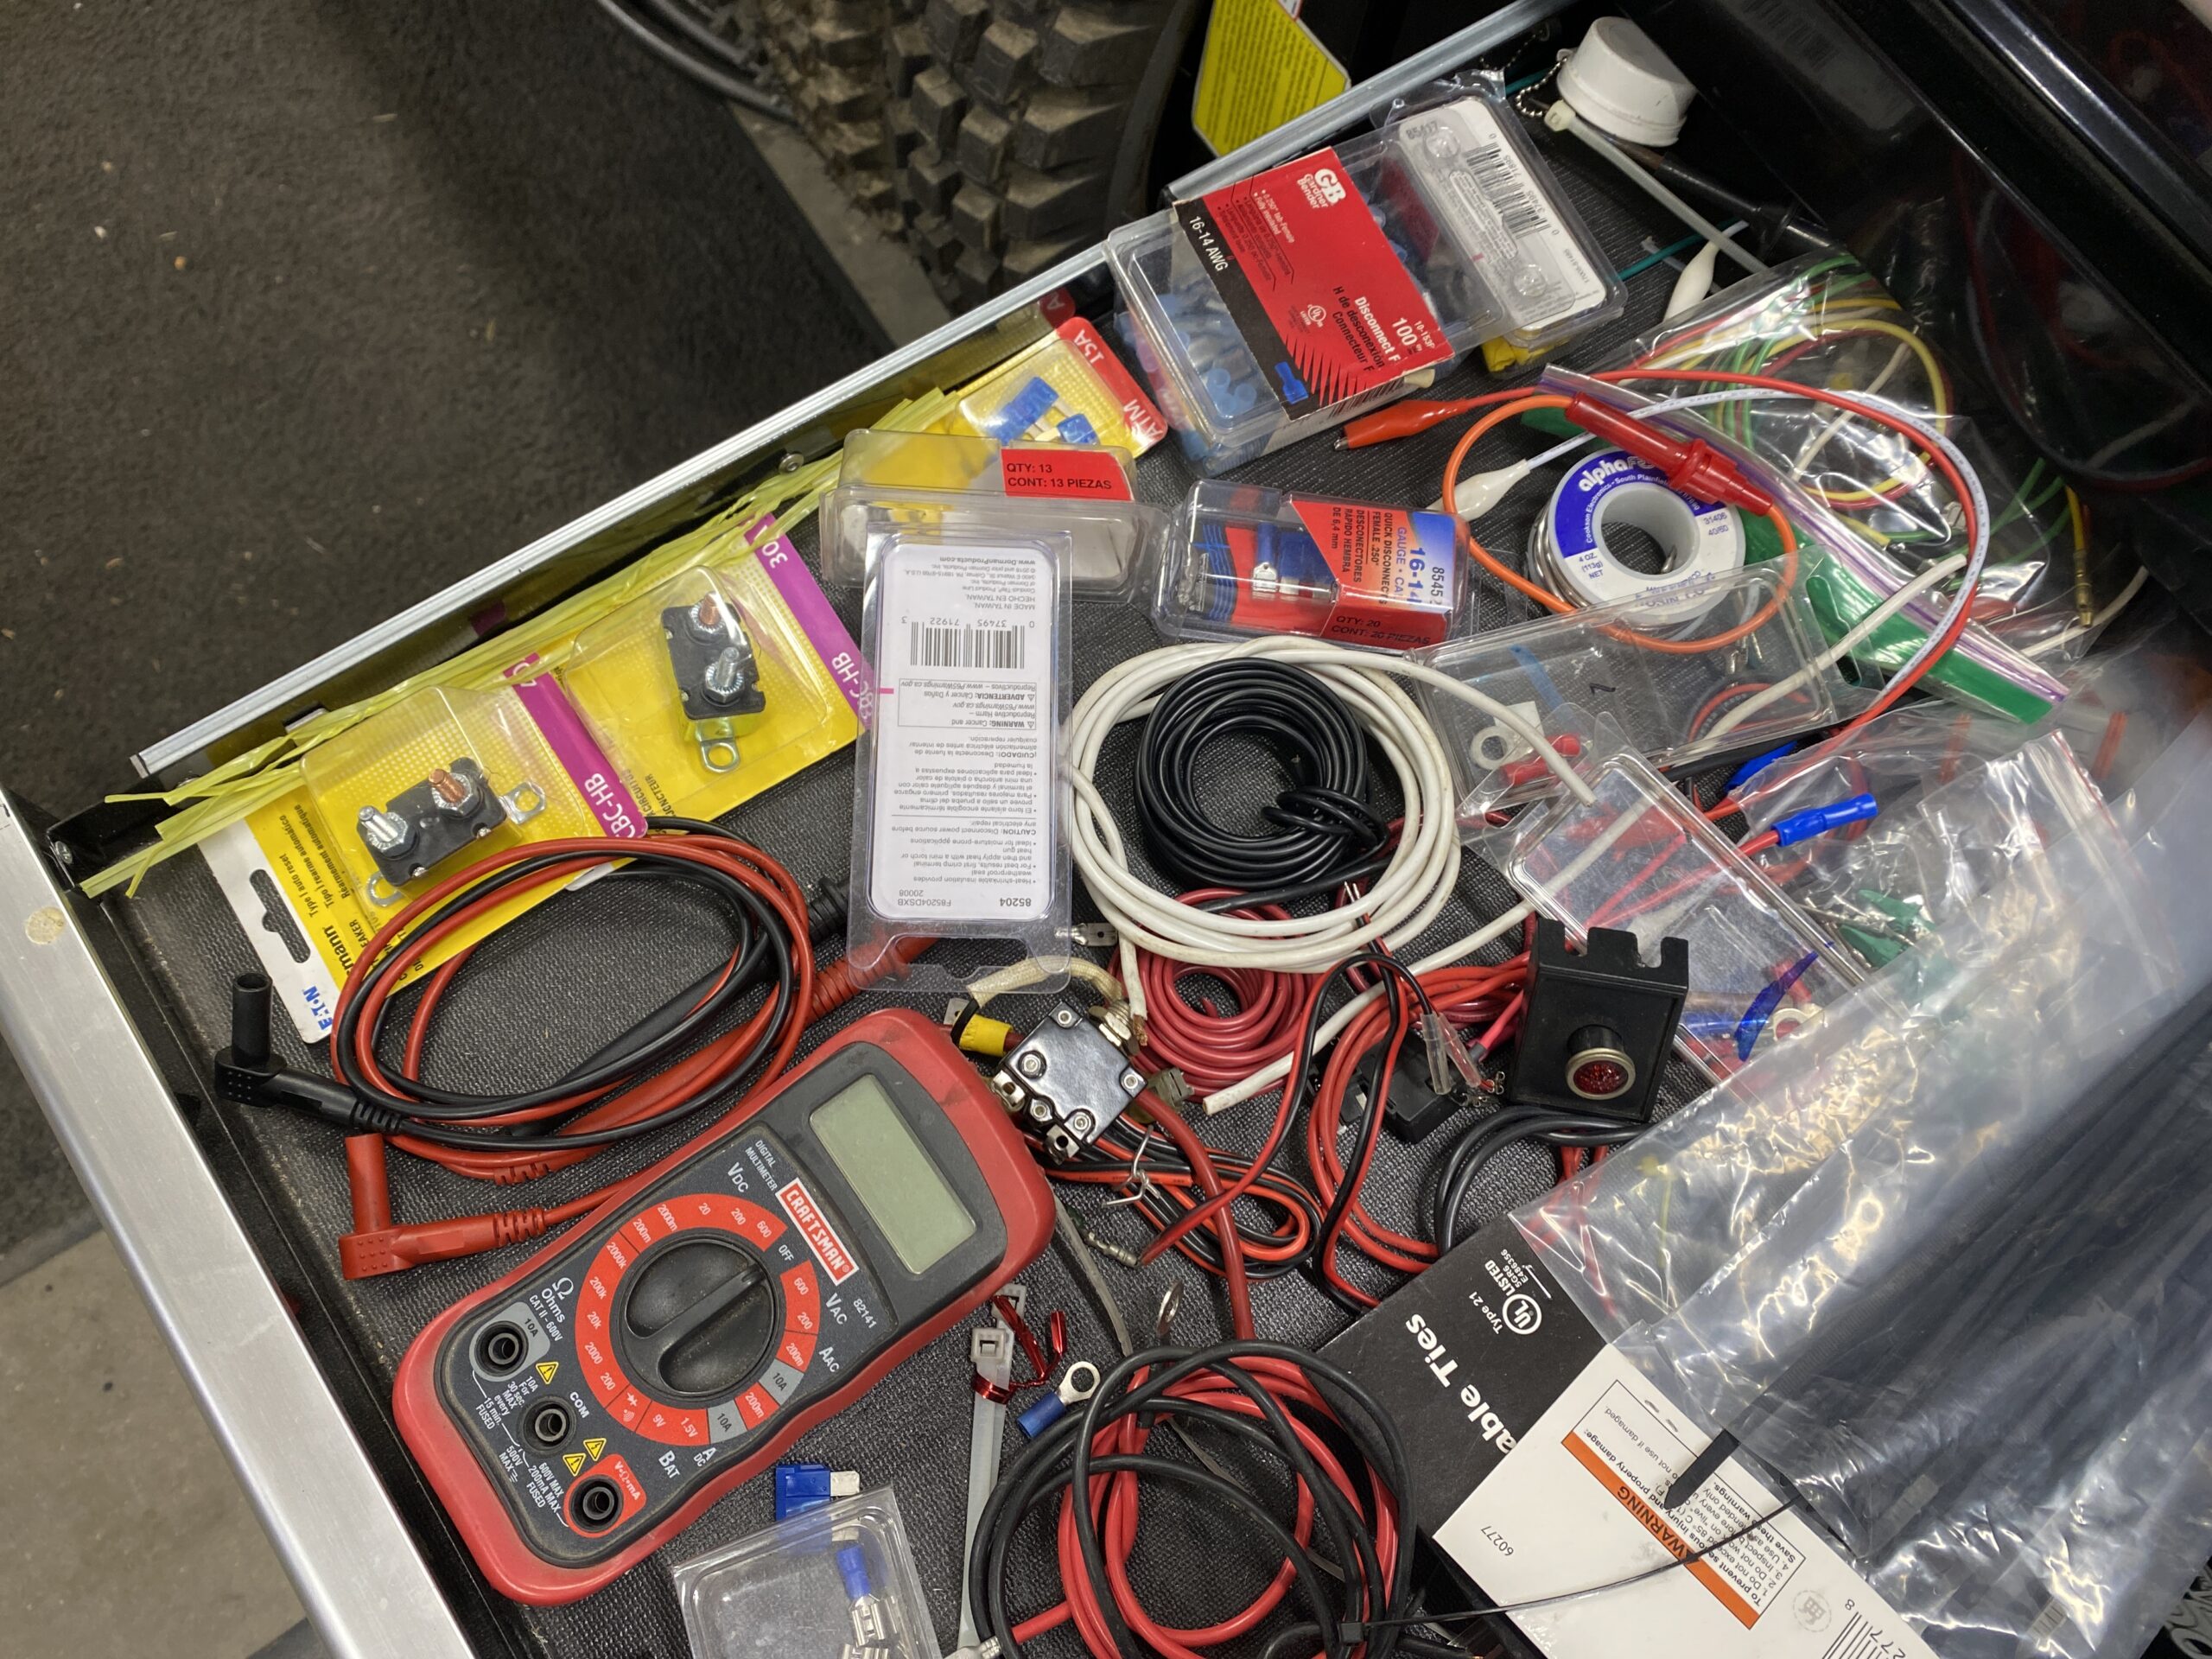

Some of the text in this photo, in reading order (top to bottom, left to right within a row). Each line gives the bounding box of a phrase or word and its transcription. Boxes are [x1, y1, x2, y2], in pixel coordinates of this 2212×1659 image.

[1297, 178, 1320, 209] Bender
[1303, 173, 1329, 208] Gardner
[1314, 168, 1347, 205] GB
[1190, 216, 1229, 271] 16-14 AWG
[1332, 286, 1344, 295] H
[1338, 296, 1351, 308] de
[1332, 311, 1369, 364] Connecteur
[1354, 296, 1395, 354] Disconnect
[1392, 317, 1418, 346] 100
[1071, 327, 1162, 442] ATM 15A
[1007, 463, 1052, 474] QTY: 13
[1007, 477, 1112, 489] CONT: 13 PIEZAS
[1332, 507, 1341, 517] DE
[1383, 512, 1393, 538] QUICK
[1372, 511, 1381, 543] FEMALE
[1332, 534, 1338, 549] mm
[1342, 508, 1353, 573] RAPIDO HEMBRA
[1354, 509, 1364, 582] DESCONECTORES
[1396, 527, 1407, 565] GAUGE
[939, 556, 1035, 565] www.DormanProducts.com
[1581, 560, 1604, 572] (113g)
[1588, 570, 1604, 580] NET
[929, 617, 959, 626] 71922
[1336, 615, 1381, 627] QTY: 20
[1385, 632, 1431, 645] PIEZAS
[276, 814, 306, 857] automático
[292, 804, 324, 851] automatique
[279, 853, 295, 874] reset
[302, 856, 321, 885] rearme
[290, 874, 304, 892] auto
[302, 895, 320, 917] Type
[319, 888, 335, 907] Tipo
[999, 897, 1031, 906] 85204
[755, 1140, 777, 1168] DIGITAL
[745, 1147, 778, 1192] MULTIMETER
[657, 1204, 678, 1233] 2000m
[698, 1202, 711, 1216] 20
[731, 1207, 747, 1225] 200
[632, 1217, 651, 1244] 200m
[757, 1220, 772, 1238] 600
[785, 1189, 846, 1271] CRAFTSMAN
[607, 1242, 627, 1270] 2000k
[779, 1244, 795, 1262] OFF
[1501, 1249, 1529, 1283] E486356
[589, 1276, 607, 1300] 200k
[794, 1277, 809, 1295] 600
[1484, 1260, 1516, 1296] LISTED
[1503, 1265, 1522, 1288] 5GR6
[529, 1294, 543, 1311] CAT
[545, 1320, 563, 1342] 600V
[540, 1287, 568, 1323] Ohms
[853, 1298, 877, 1329] 82141
[1469, 1291, 1503, 1335] Type 21
[524, 1318, 539, 1338] 10A
[587, 1311, 602, 1331] 20k
[797, 1312, 813, 1330] 200
[584, 1342, 603, 1365] 2000
[785, 1343, 804, 1367] 200m
[506, 1381, 526, 1408] 30 sec.
[518, 1381, 531, 1395] For
[524, 1376, 539, 1391] 10A
[601, 1372, 616, 1391] 200
[772, 1372, 788, 1391] 10A
[1406, 1313, 1516, 1453] able Ties
[483, 1397, 504, 1425] 15 min.
[492, 1395, 510, 1416] every
[501, 1389, 518, 1408] MAX
[569, 1391, 590, 1419] COM
[744, 1391, 765, 1420] 200m
[475, 1404, 495, 1429] FUSED
[652, 1414, 666, 1427] 9V
[680, 1417, 699, 1438] 1.5V
[716, 1413, 732, 1432] 10A
[1602, 1405, 1639, 1441] damaged.
[505, 1446, 524, 1466] 500V
[1582, 1427, 1618, 1462] damage:
[499, 1452, 514, 1472] MAX
[658, 1449, 681, 1479] BAT
[528, 1465, 562, 1513] 200mA MAX
[538, 1462, 564, 1498] 600V MAX
[1616, 1459, 1651, 1494] property
[526, 1481, 546, 1509] FUSED
[1618, 1486, 1686, 1556] WARNING
[1664, 1508, 1690, 1534] injury
[1711, 1480, 1796, 1562] Save warnings.
[1480, 1525, 1515, 1556] 60277
[1718, 1560, 1752, 1593] prevent
[1750, 1592, 1761, 1604] To
[1843, 1598, 1855, 1611] 8
